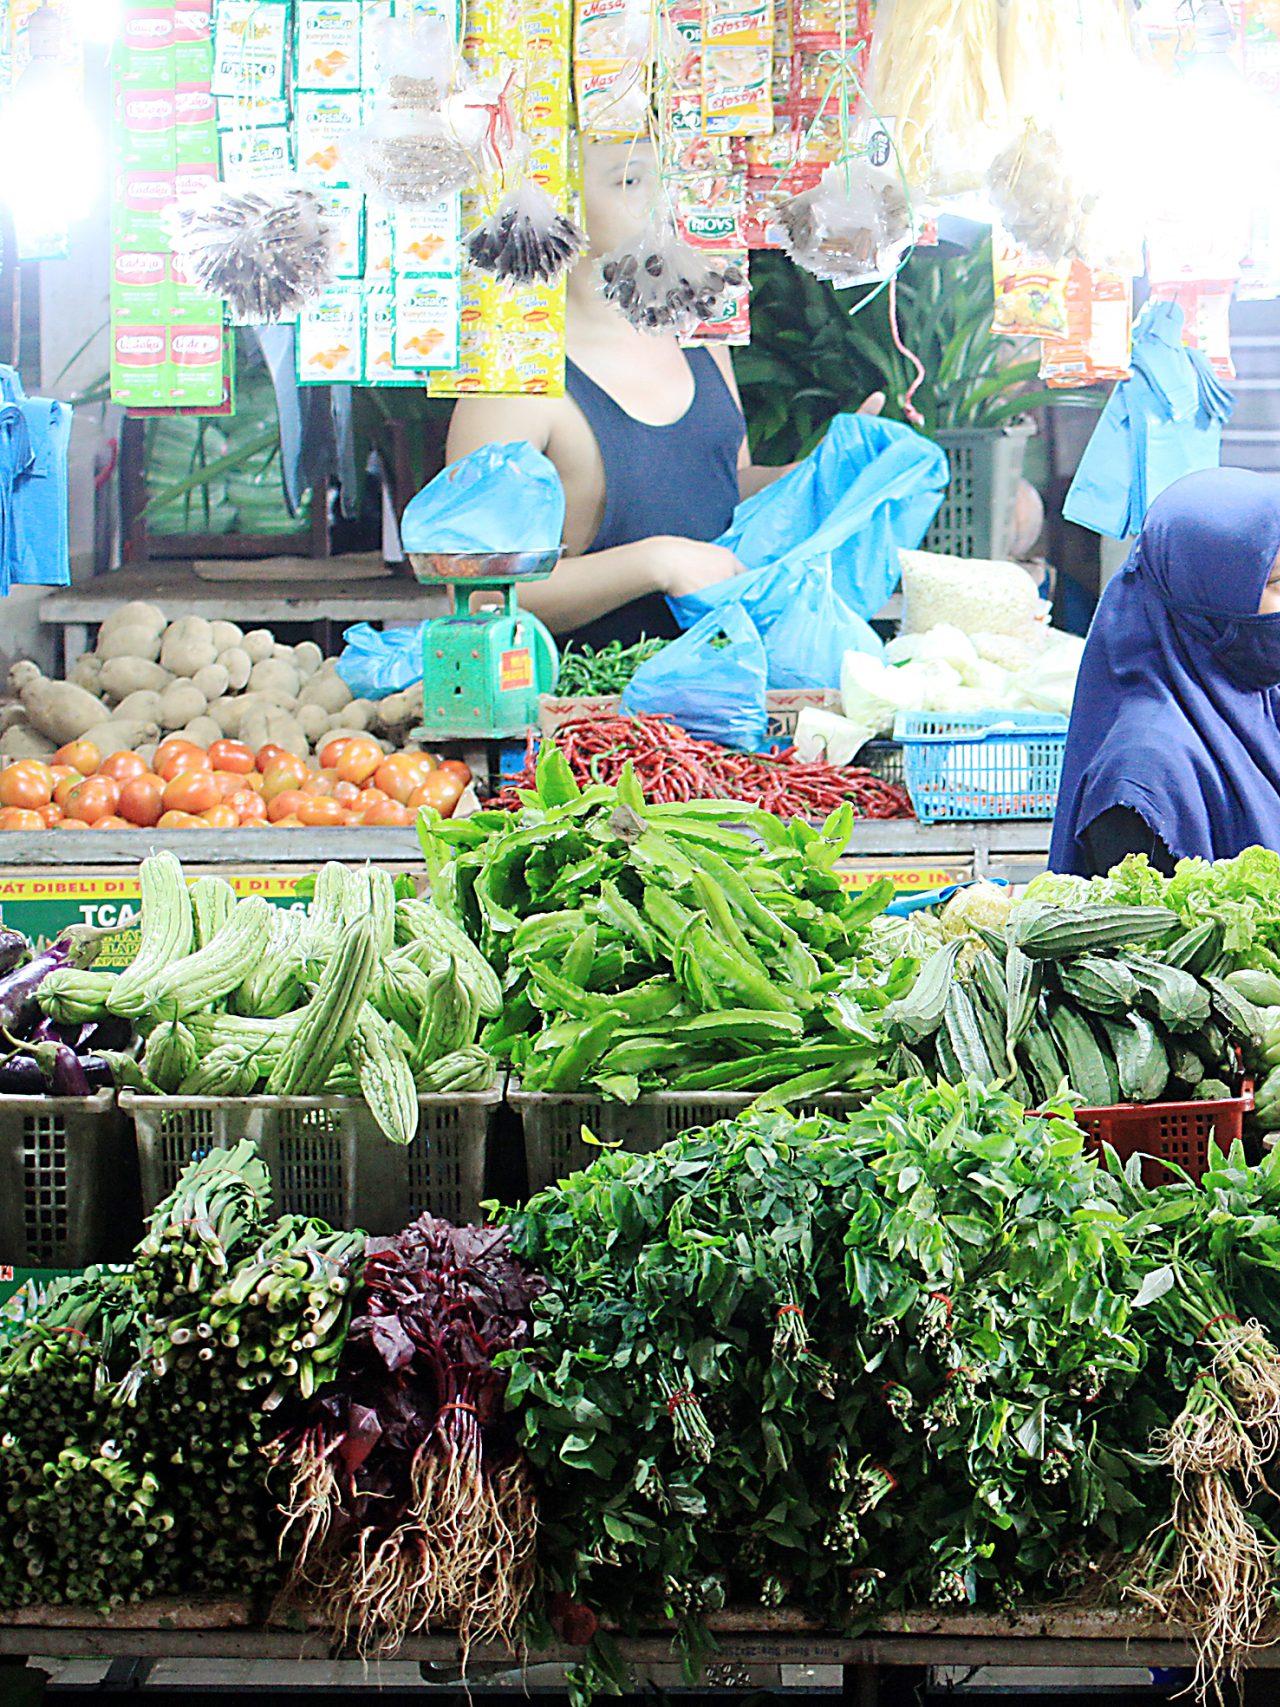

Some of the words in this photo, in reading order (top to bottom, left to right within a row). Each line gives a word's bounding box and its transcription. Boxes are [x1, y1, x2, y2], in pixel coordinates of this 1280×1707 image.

[711, 14, 766, 36] Masako
[711, 86, 765, 108] Masako
[691, 218, 734, 231] SAORI
[33, 882, 96, 893] DIBELI
[105, 881, 124, 892] DI
[249, 879, 269, 890] DI
